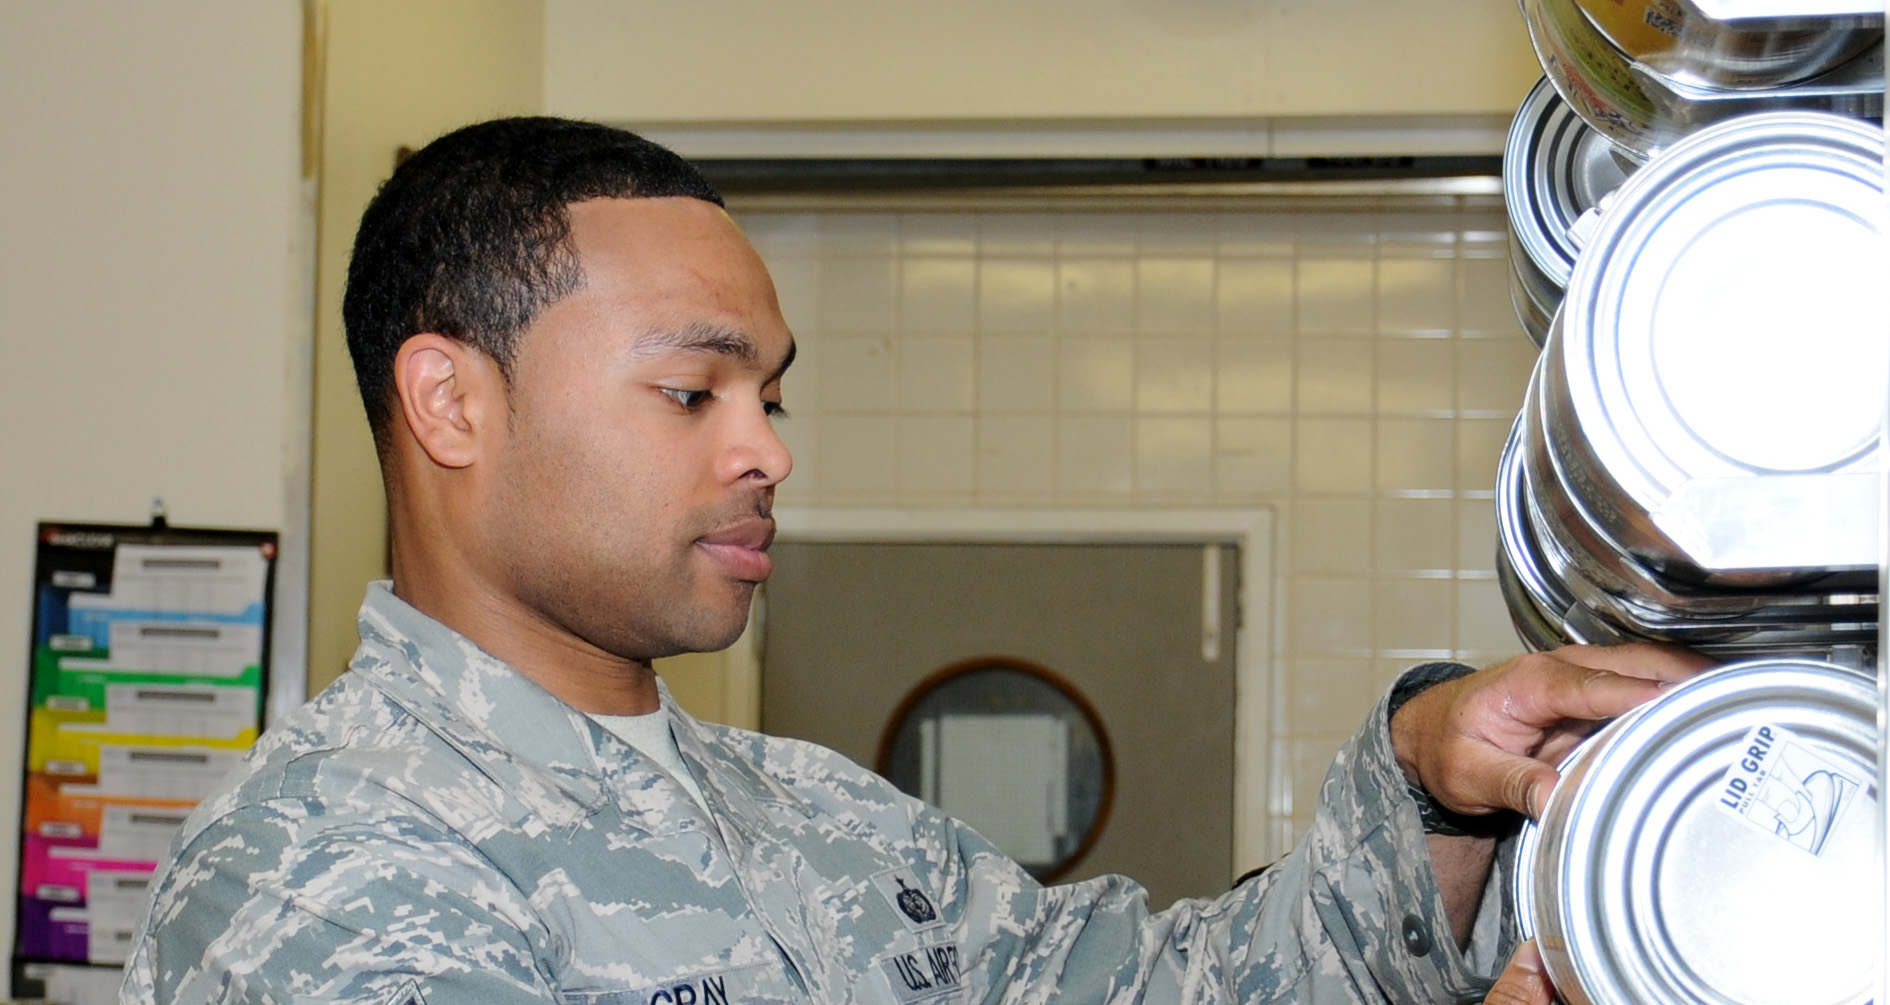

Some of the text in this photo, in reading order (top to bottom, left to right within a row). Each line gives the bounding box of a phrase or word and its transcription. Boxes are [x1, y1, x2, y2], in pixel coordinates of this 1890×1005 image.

[1720, 726, 1775, 809] LID GRIP
[1738, 769, 1767, 815] PULL TAB
